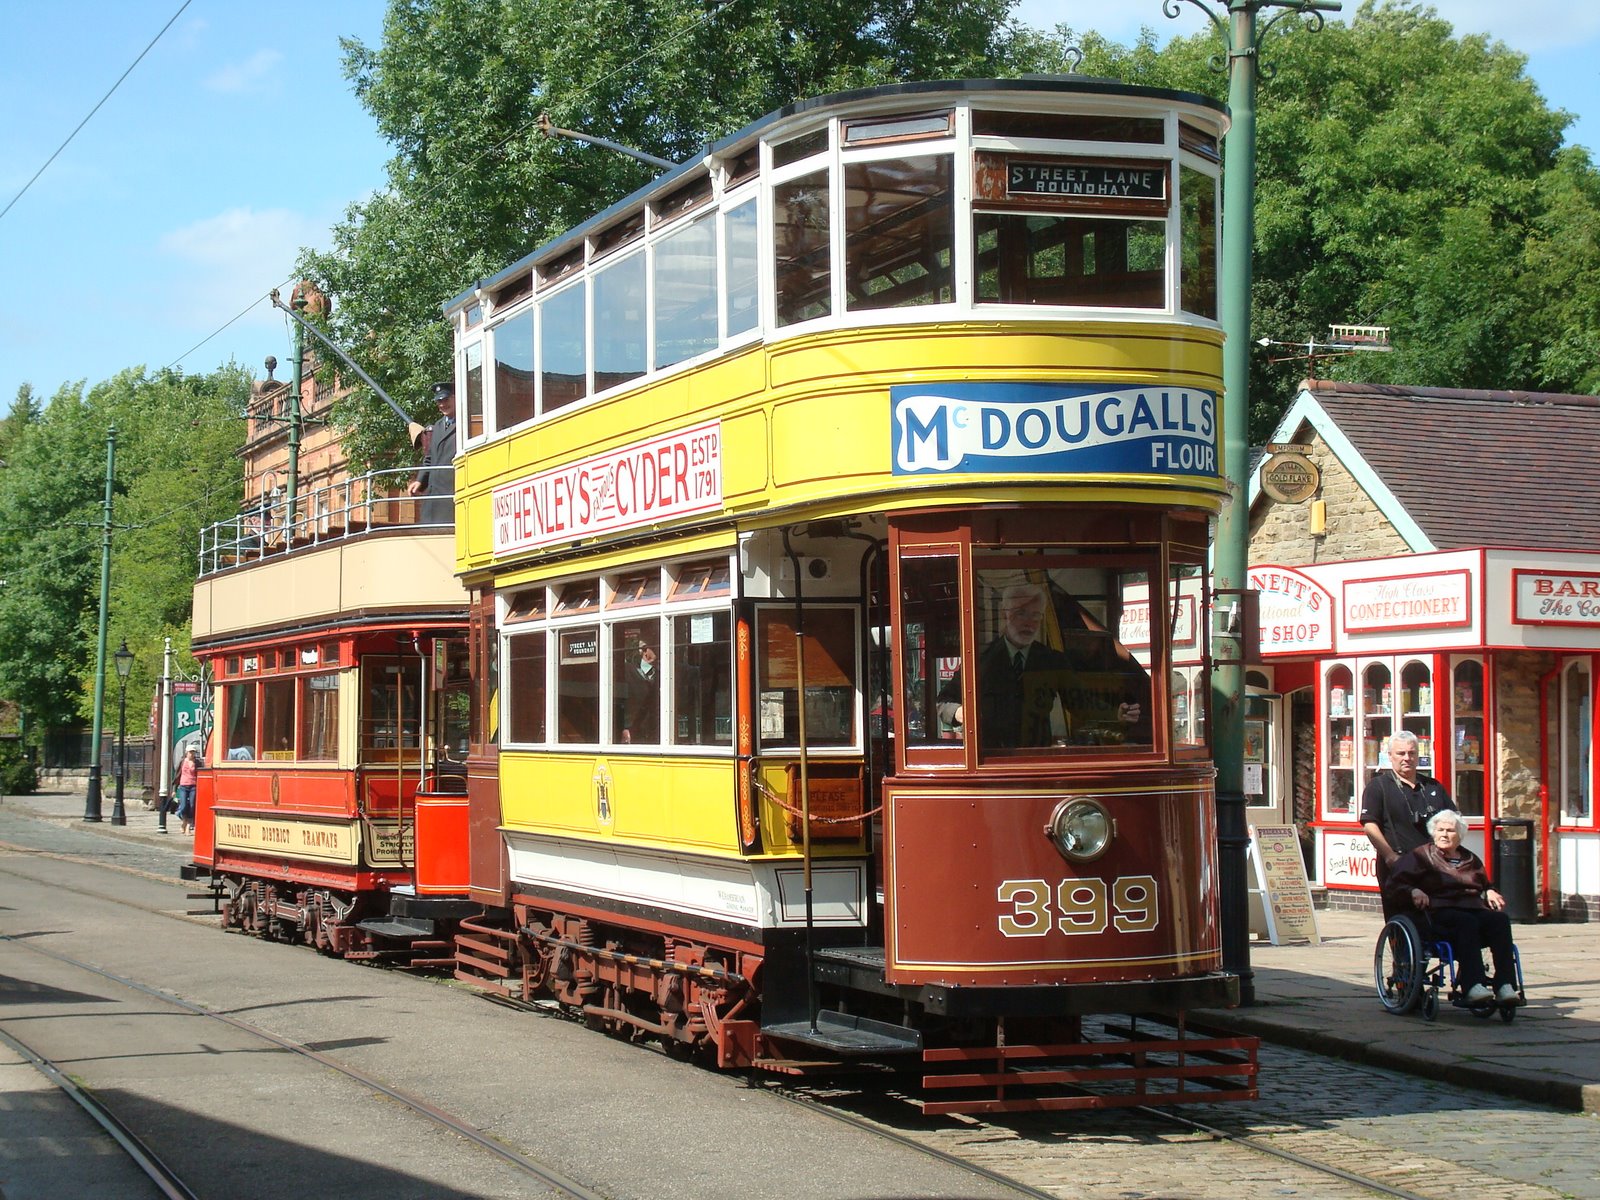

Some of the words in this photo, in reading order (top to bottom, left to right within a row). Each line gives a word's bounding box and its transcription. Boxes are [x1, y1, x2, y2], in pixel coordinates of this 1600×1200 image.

[1012, 167, 1089, 184] STREET
[1103, 170, 1152, 189] LANE
[1036, 180, 1131, 196] ROUNDHAY
[1151, 442, 1215, 472] FLOUR
[694, 468, 716, 500] 1791
[1270, 474, 1288, 482] GOLD
[1289, 474, 1311, 483] FLAKE
[513, 468, 591, 541] HENLEY'S
[615, 442, 690, 517] CYDER
[493, 493, 513, 520] INSIST
[500, 521, 510, 545] ON
[1251, 574, 1322, 611] NETT'S
[1534, 579, 1600, 597] BAR
[1350, 597, 1460, 619] CONFECTIONERY
[1539, 599, 1572, 616] The
[1577, 600, 1600, 617] Co
[1272, 624, 1320, 642] SHOP
[227, 823, 251, 840] PAISLEY
[261, 827, 290, 844] DISTRICT
[302, 830, 338, 849] TRAMWAYS
[1348, 857, 1377, 877] WOO
[997, 875, 1160, 937] 399
